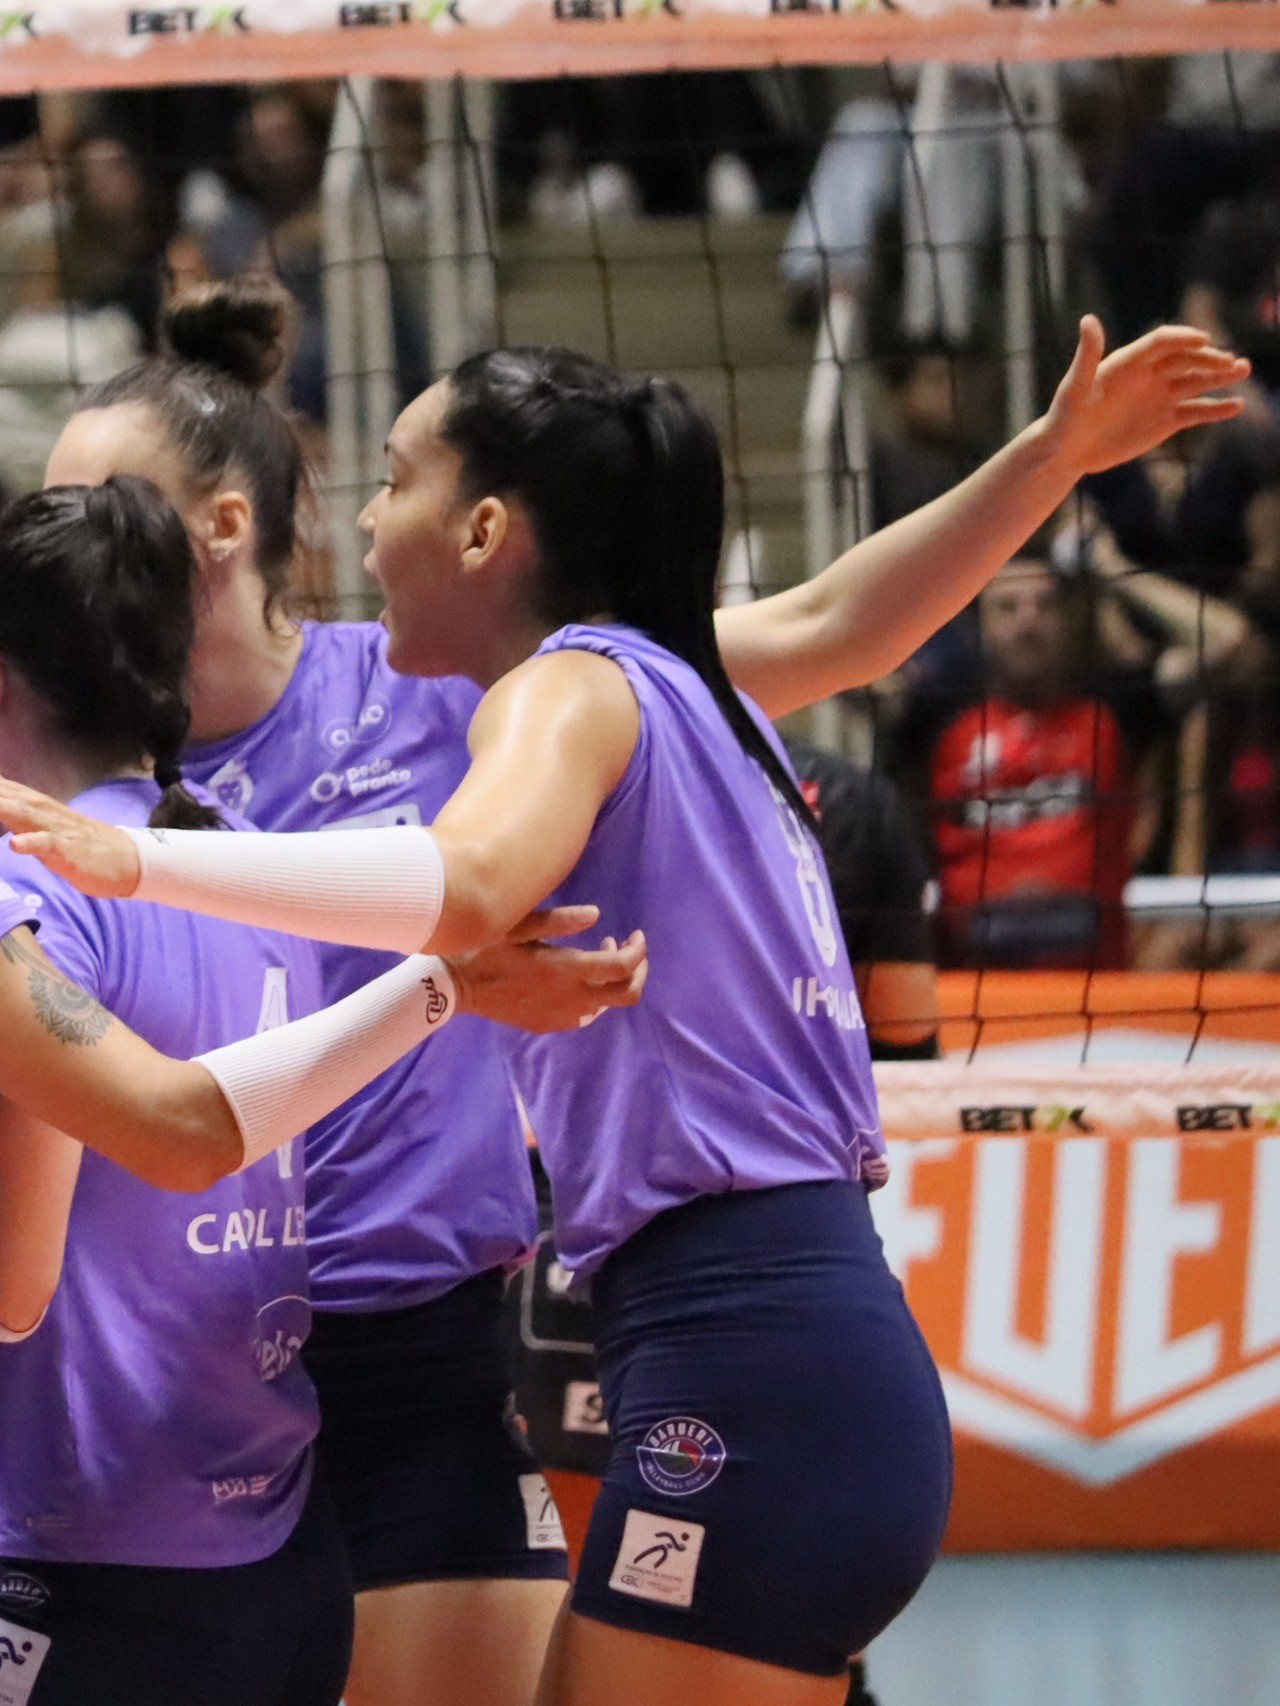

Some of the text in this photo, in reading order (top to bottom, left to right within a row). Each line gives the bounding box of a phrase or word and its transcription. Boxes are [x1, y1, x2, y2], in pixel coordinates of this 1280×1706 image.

[127, 6, 249, 37] BET7K
[960, 1104, 1091, 1133] BET7K
[649, 1422, 713, 1448] BARUERI
